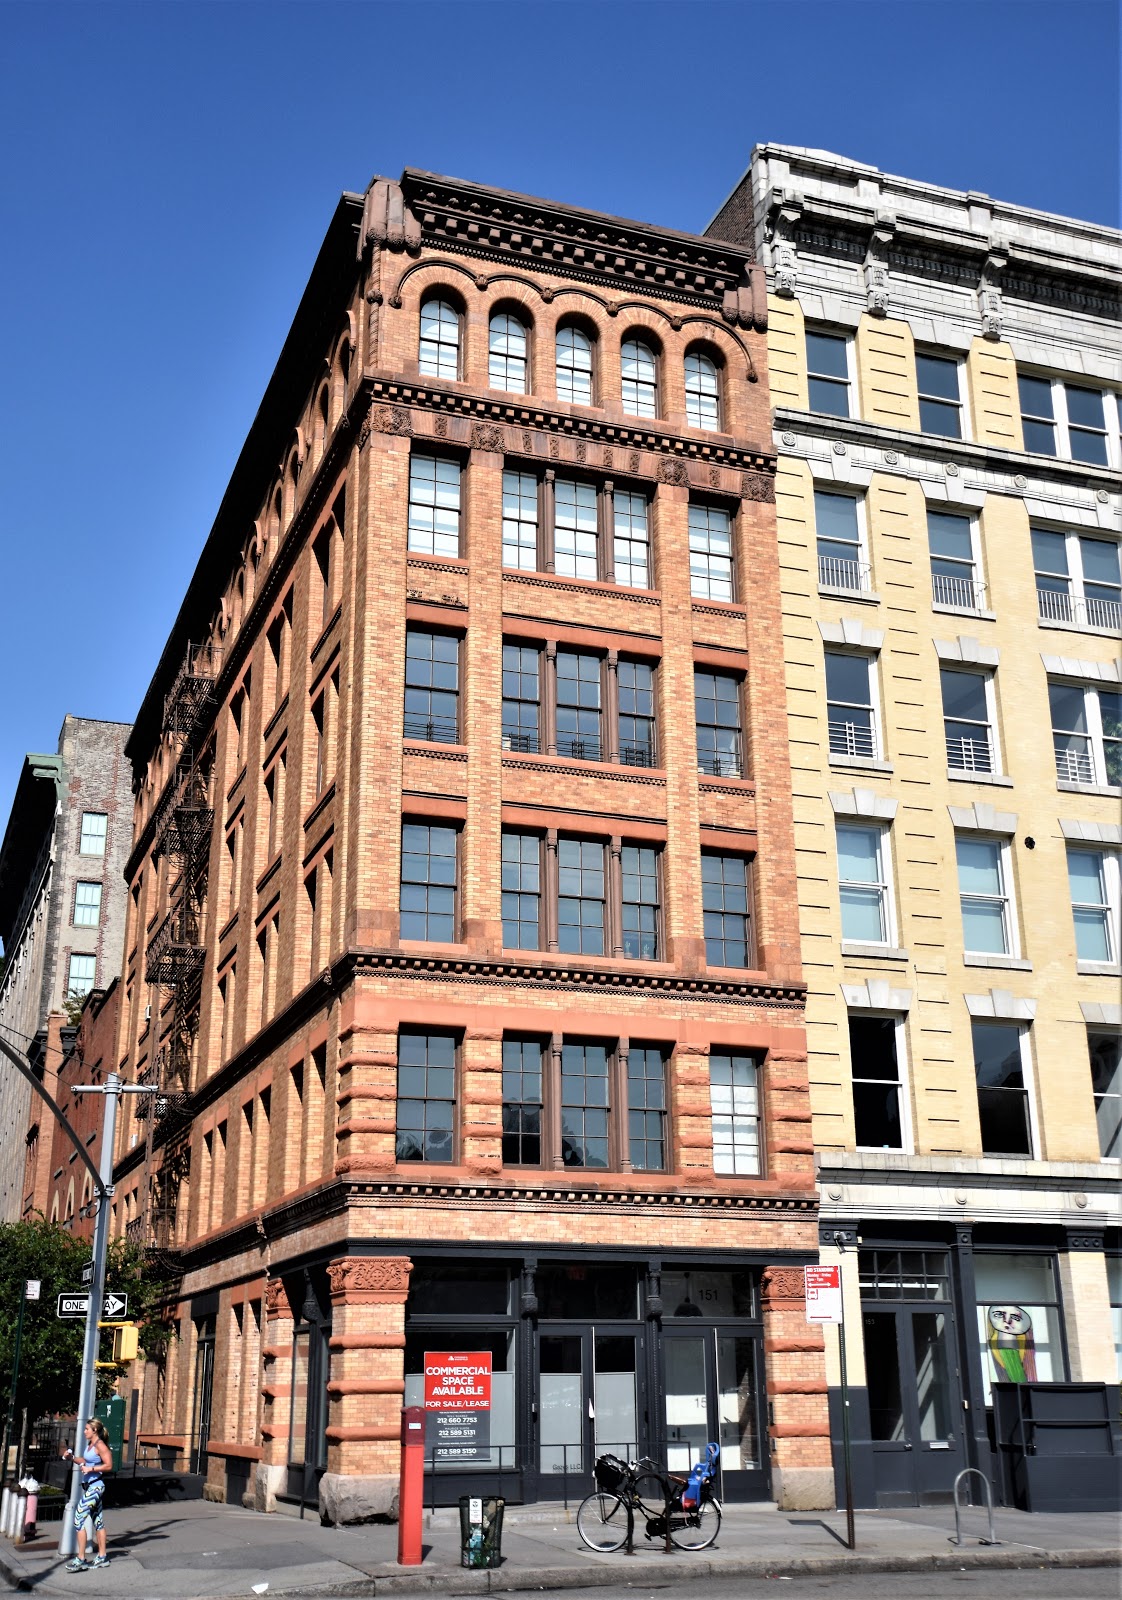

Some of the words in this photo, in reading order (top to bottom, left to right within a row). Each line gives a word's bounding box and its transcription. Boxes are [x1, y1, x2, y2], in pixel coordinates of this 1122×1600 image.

[699, 1290, 718, 1300] 151
[65, 1301, 85, 1309] ONE
[103, 1301, 117, 1309] AY
[426, 1367, 490, 1375] COMMERCIAL
[442, 1377, 474, 1385] SPACE
[432, 1386, 484, 1395] AVAILABLE
